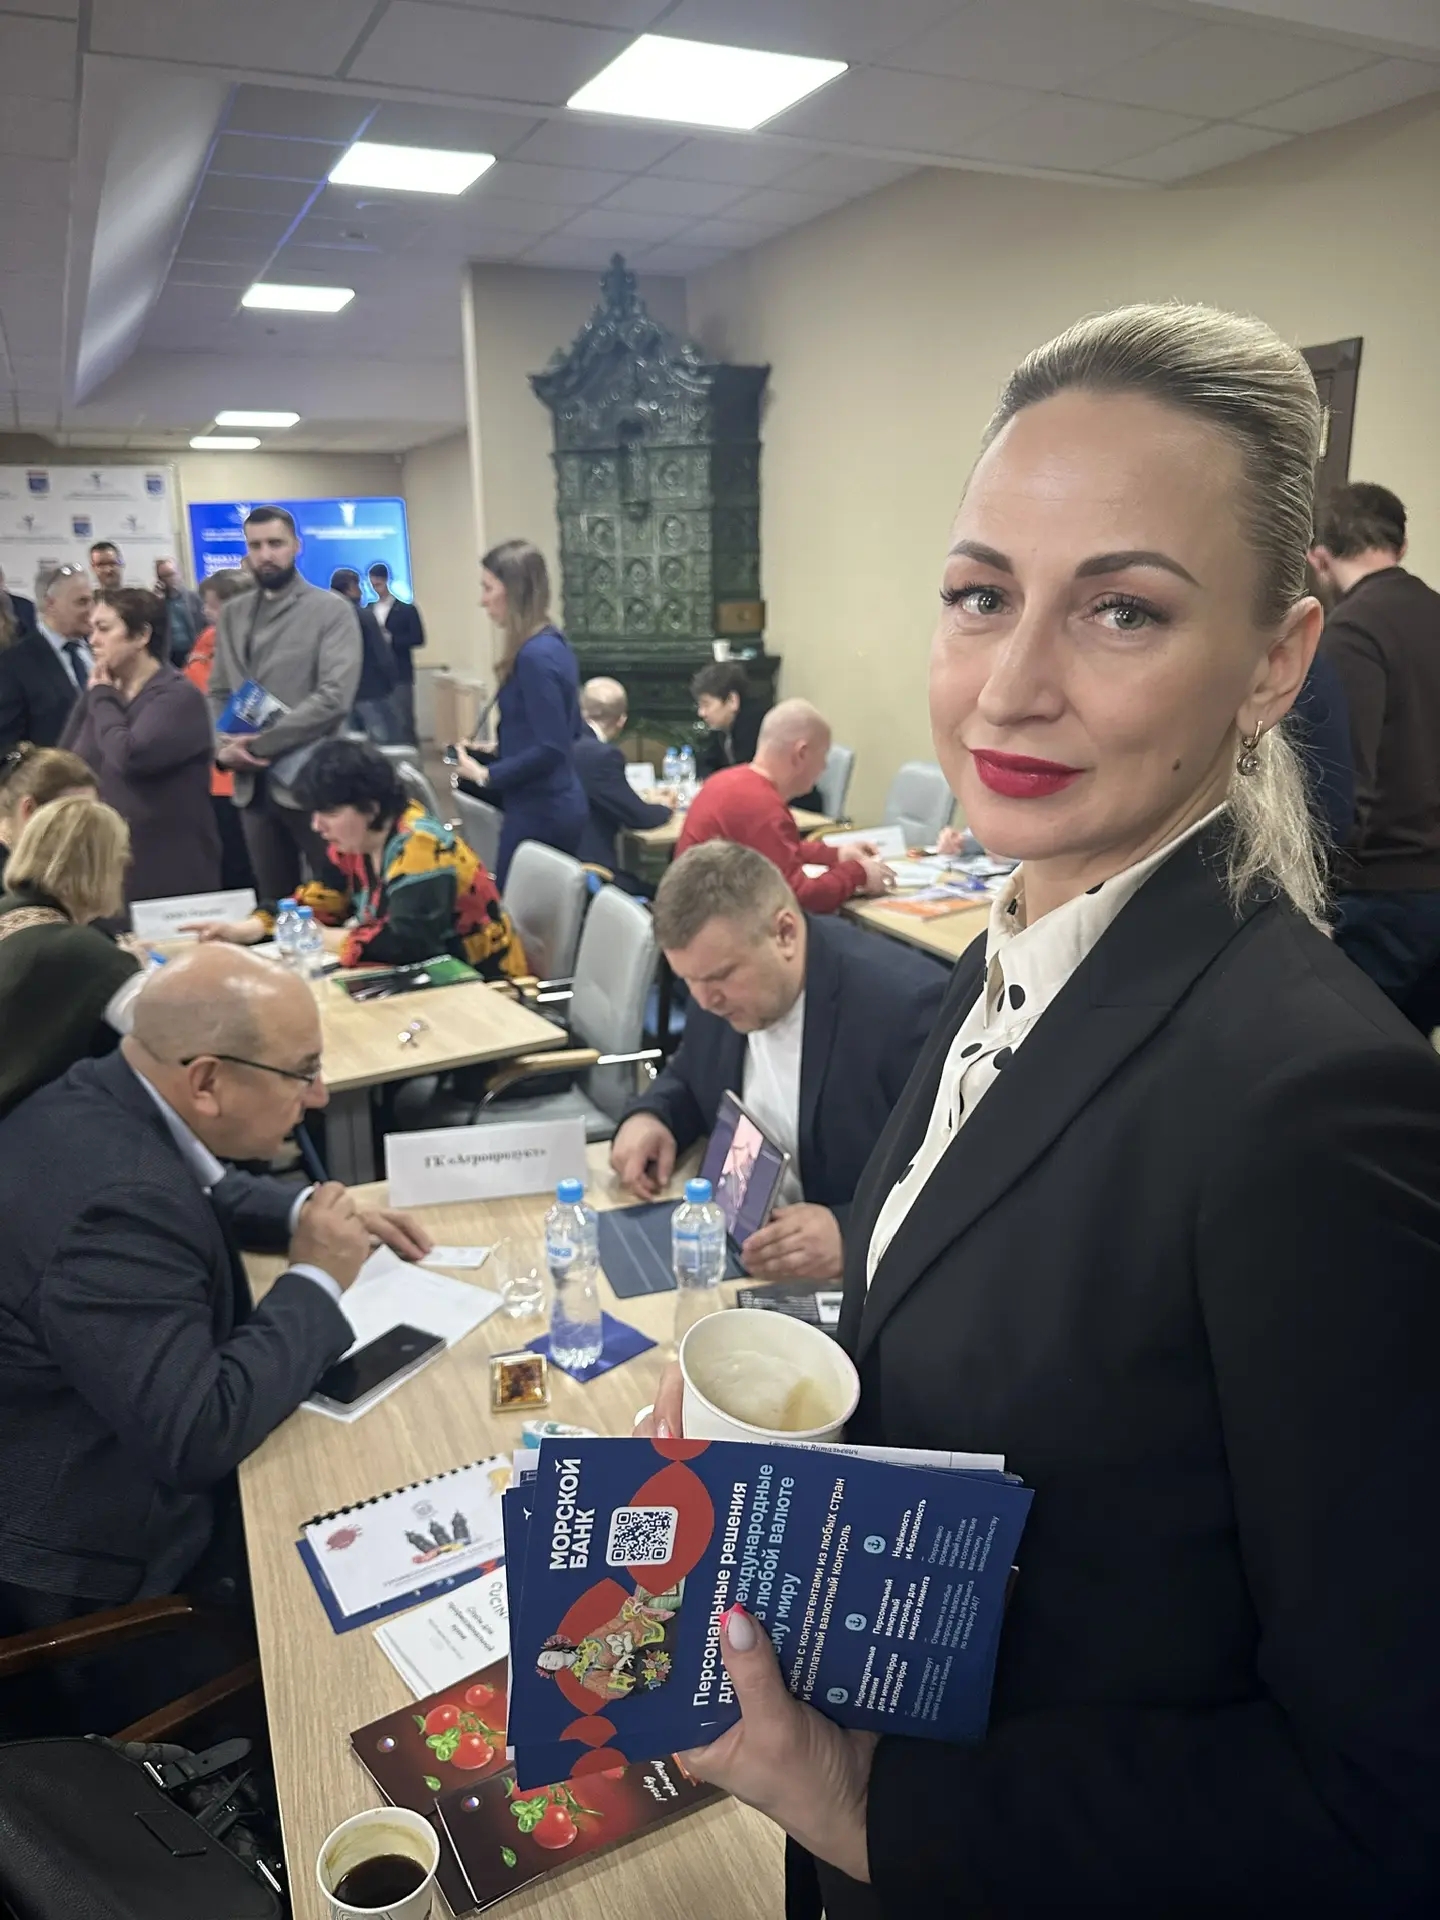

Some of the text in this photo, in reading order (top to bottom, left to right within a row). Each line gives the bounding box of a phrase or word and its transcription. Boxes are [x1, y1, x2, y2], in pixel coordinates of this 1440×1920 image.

[424, 1154, 446, 1169] ГК
[549, 1458, 581, 1570] МОРСКОЙ
[829, 1478, 846, 1511] стран
[569, 1508, 595, 1569] БАНК
[736, 1464, 774, 1604] еждународные
[756, 1549, 780, 1607] любой
[768, 1476, 795, 1544] валюте
[820, 1513, 837, 1550] любых
[892, 1510, 912, 1557] Надёжность
[905, 1499, 927, 1552] безопасность
[817, 1552, 828, 1566] из
[959, 1560, 966, 1569] на
[489, 1581, 509, 1620] CUCIN
[692, 1482, 748, 1707] Персональные решения
[776, 1573, 801, 1618] миру
[799, 1567, 825, 1647] контрагентами
[803, 1632, 826, 1692] бесплатный
[818, 1577, 840, 1630] валютный
[831, 1525, 851, 1575] контроль
[872, 1579, 893, 1635] Персональный
[897, 1583, 917, 1638] контролёр для
[908, 1576, 930, 1640] каждого клиента
[961, 1580, 975, 1606] бизнеса
[970, 1595, 980, 1610] 24/7
[885, 1599, 901, 1636] валютный
[789, 1657, 804, 1693] асчёты
[854, 1646, 876, 1707] Индивидуальные
[866, 1677, 880, 1710] решения
[878, 1653, 899, 1712] для импортёров
[890, 1661, 908, 1707] экспортёров
